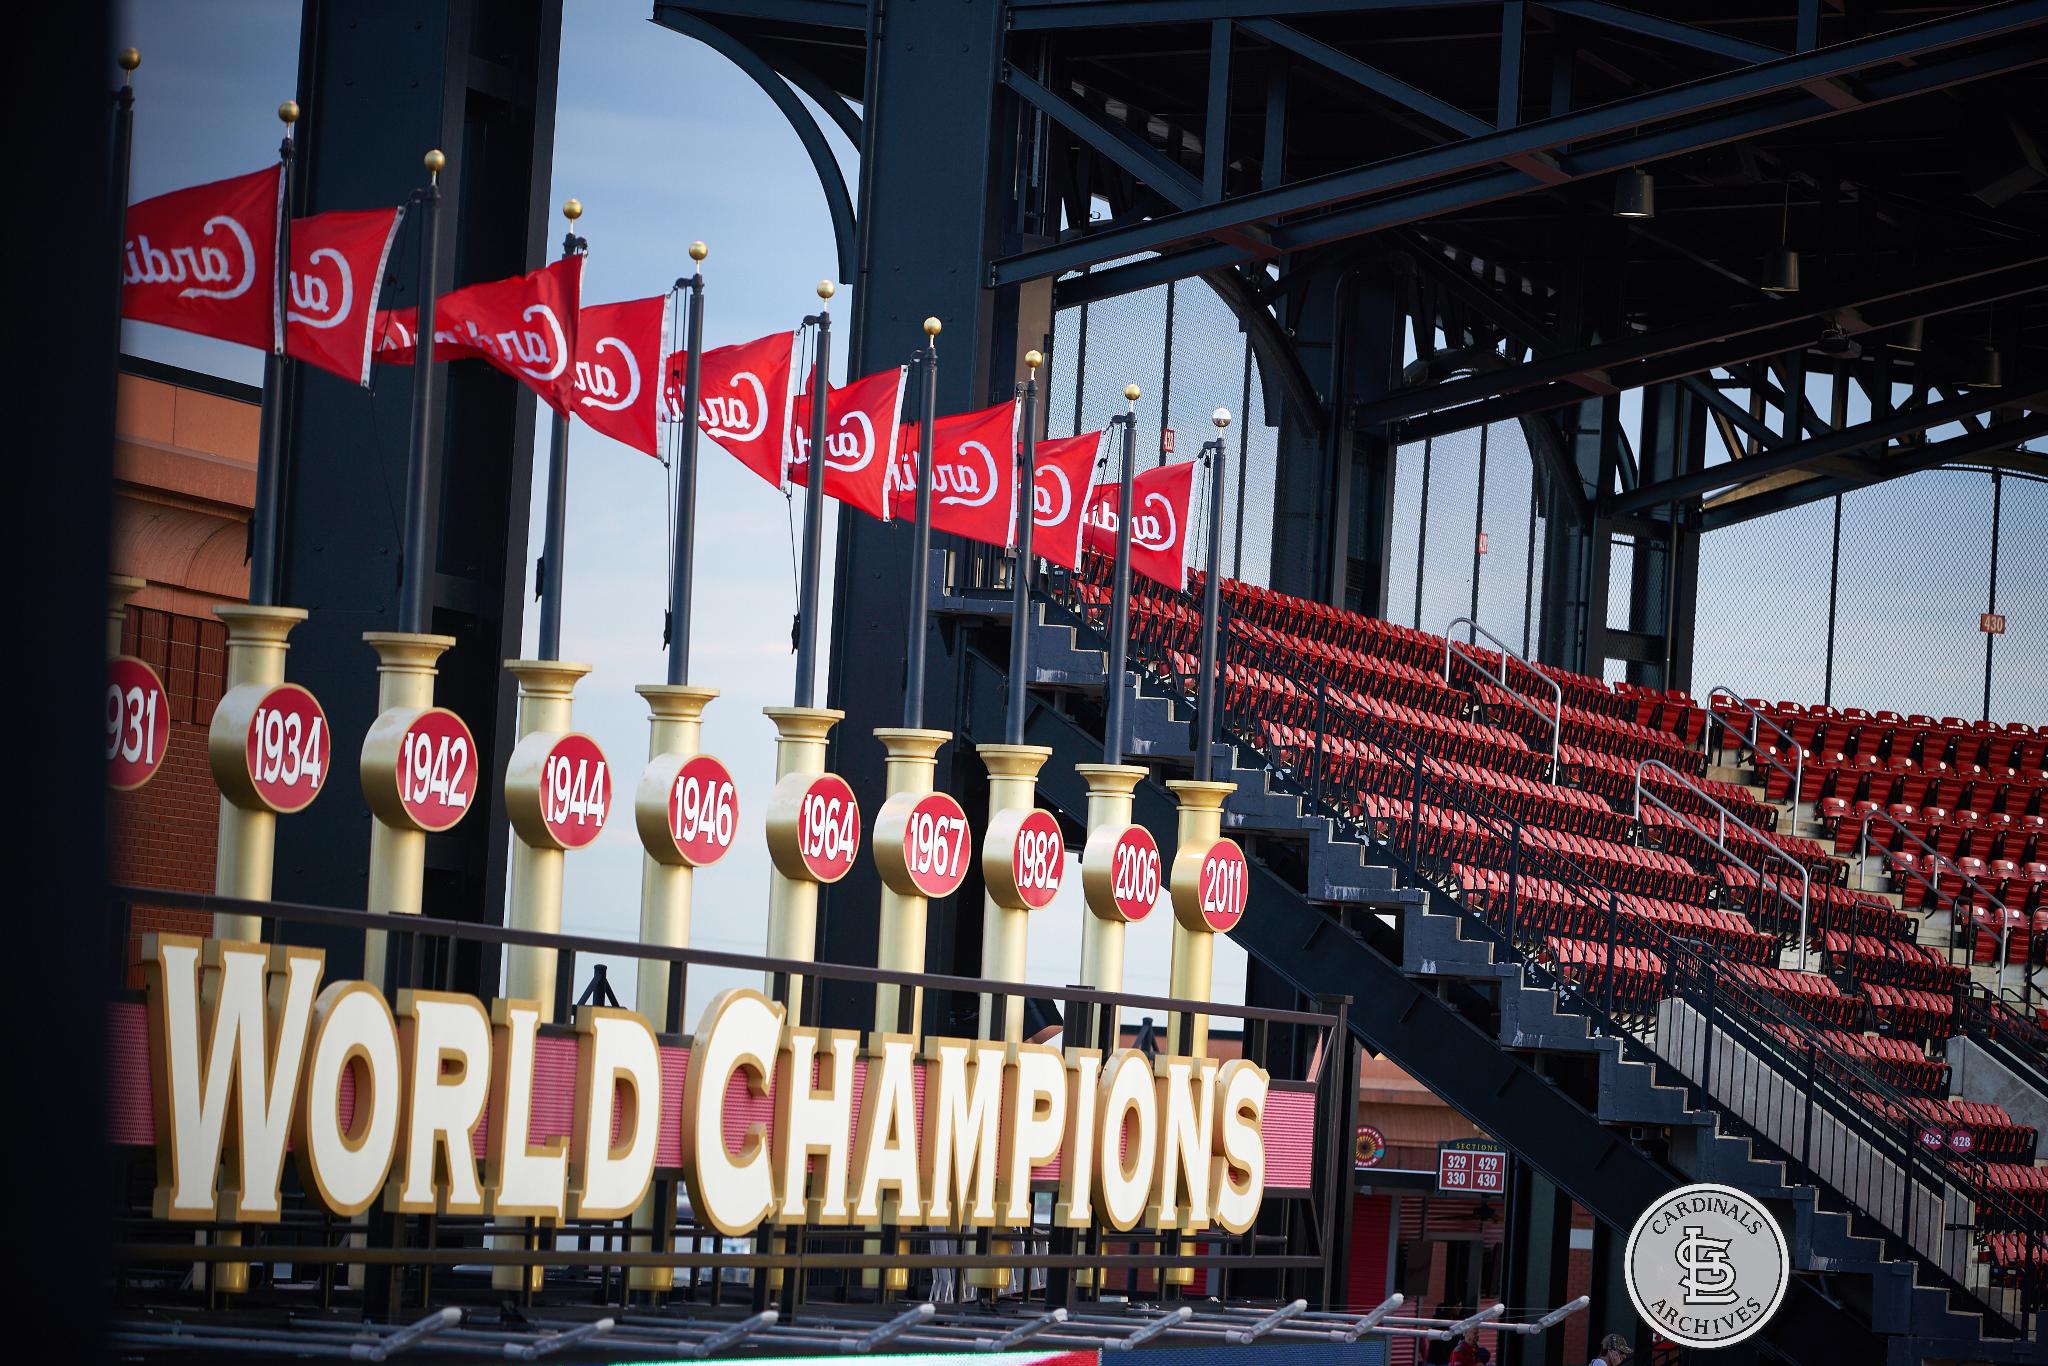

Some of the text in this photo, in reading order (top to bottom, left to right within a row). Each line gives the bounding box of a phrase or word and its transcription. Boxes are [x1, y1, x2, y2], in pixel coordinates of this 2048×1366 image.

[1984, 615, 2003, 632] 430
[254, 707, 323, 789] 1934
[404, 731, 467, 808] 1942
[546, 754, 606, 828] 1944
[673, 774, 734, 850] 1946
[803, 792, 855, 863] 1964
[909, 810, 966, 879] 1967
[1017, 828, 1060, 890] 1982
[1115, 840, 1158, 906] 2006
[1204, 849, 1243, 915] 2011
[143, 933, 1270, 1237] WORLD CHAMPIONS
[1447, 1155, 1498, 1171] 329 429
[1455, 1142, 1499, 1152] SECTIONS
[1952, 1136, 1971, 1148] 428
[1446, 1171, 1497, 1188] 330 430
